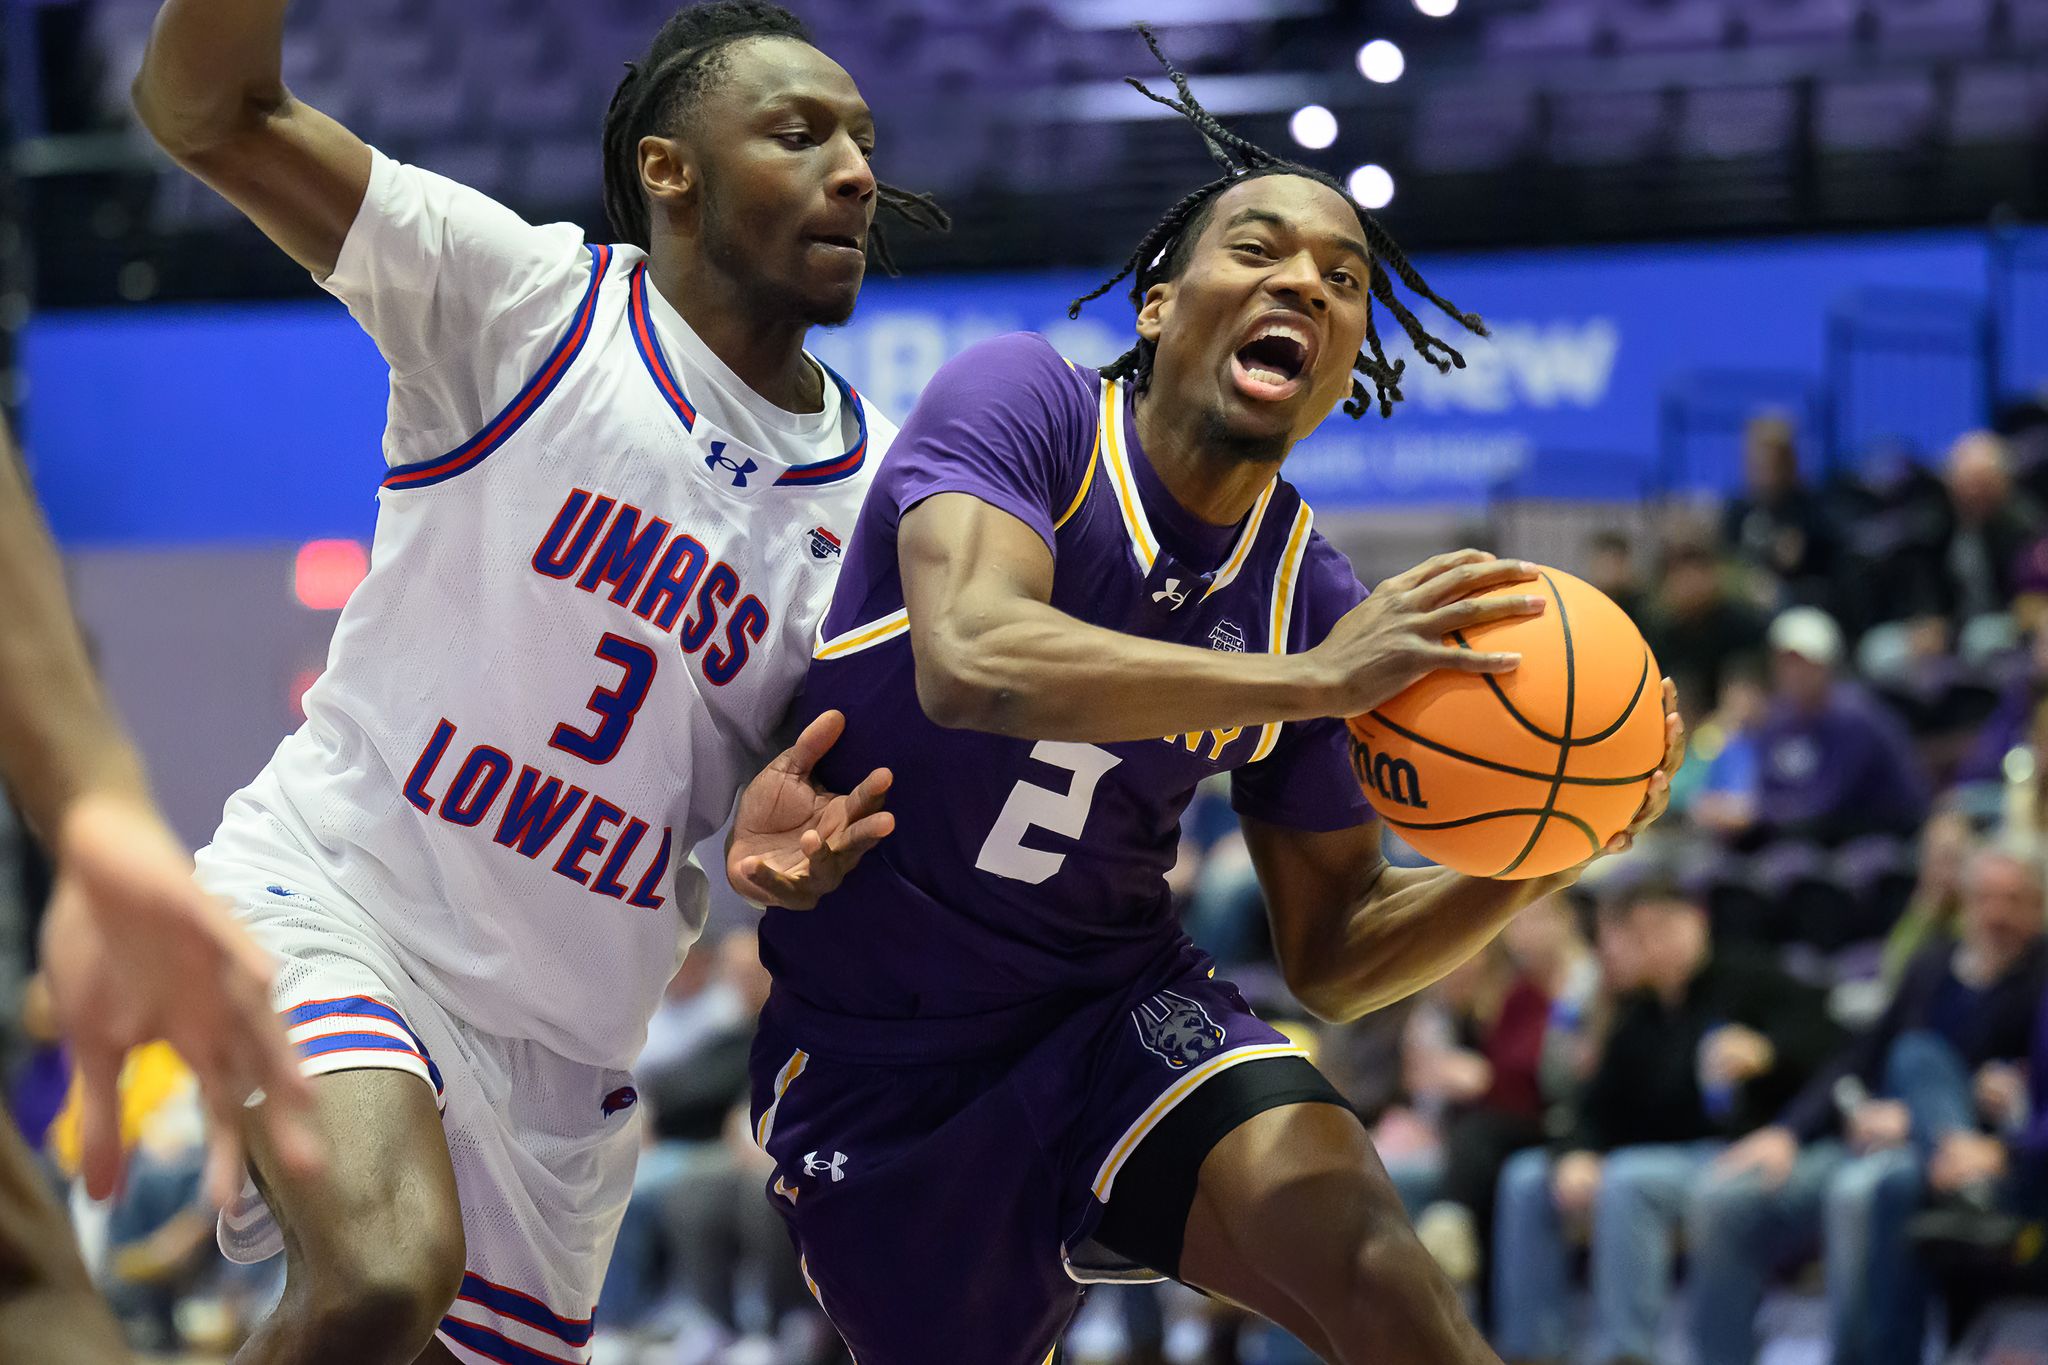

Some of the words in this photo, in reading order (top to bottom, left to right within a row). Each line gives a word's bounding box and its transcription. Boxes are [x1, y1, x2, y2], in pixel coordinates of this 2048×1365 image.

[531, 487, 770, 686] UMASS
[807, 529, 842, 558] AMERICA
[548, 632, 658, 765] 3
[1208, 626, 1246, 653] AMERICA
[402, 717, 673, 910] LOWELL
[975, 739, 1123, 885] 2
